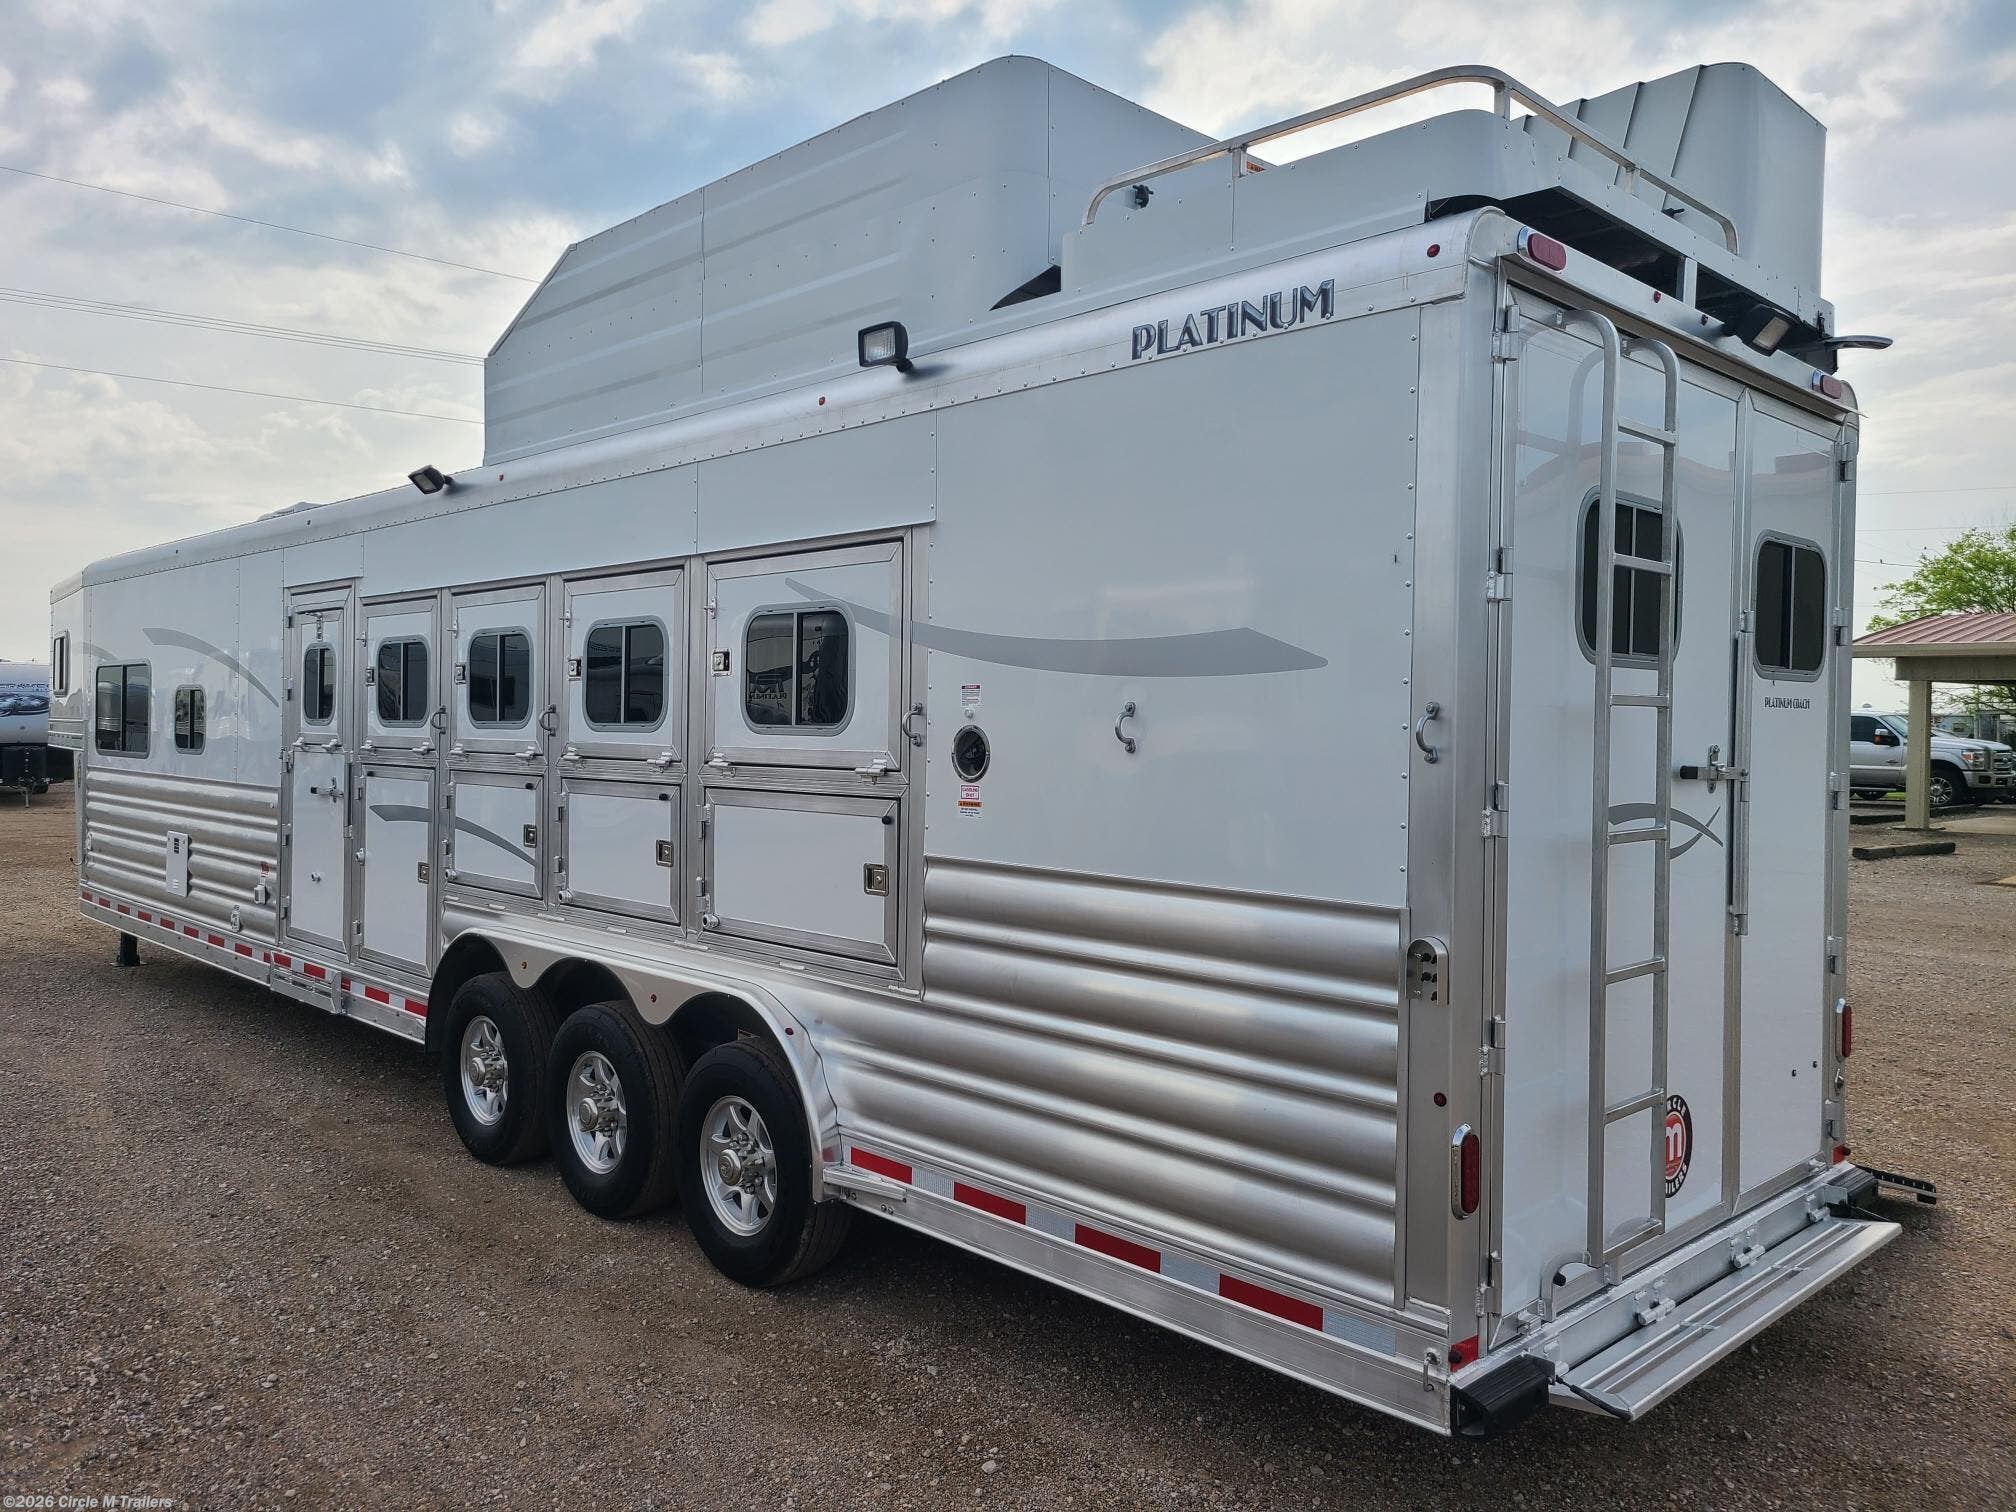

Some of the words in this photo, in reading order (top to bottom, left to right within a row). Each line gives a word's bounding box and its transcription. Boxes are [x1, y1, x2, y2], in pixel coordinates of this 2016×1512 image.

[1131, 278, 1335, 361] PLATINUM
[1764, 696, 1792, 708] PLATINUM
[1666, 1096, 1687, 1116] RCLE
[1665, 1164, 1688, 1194] ILERS
